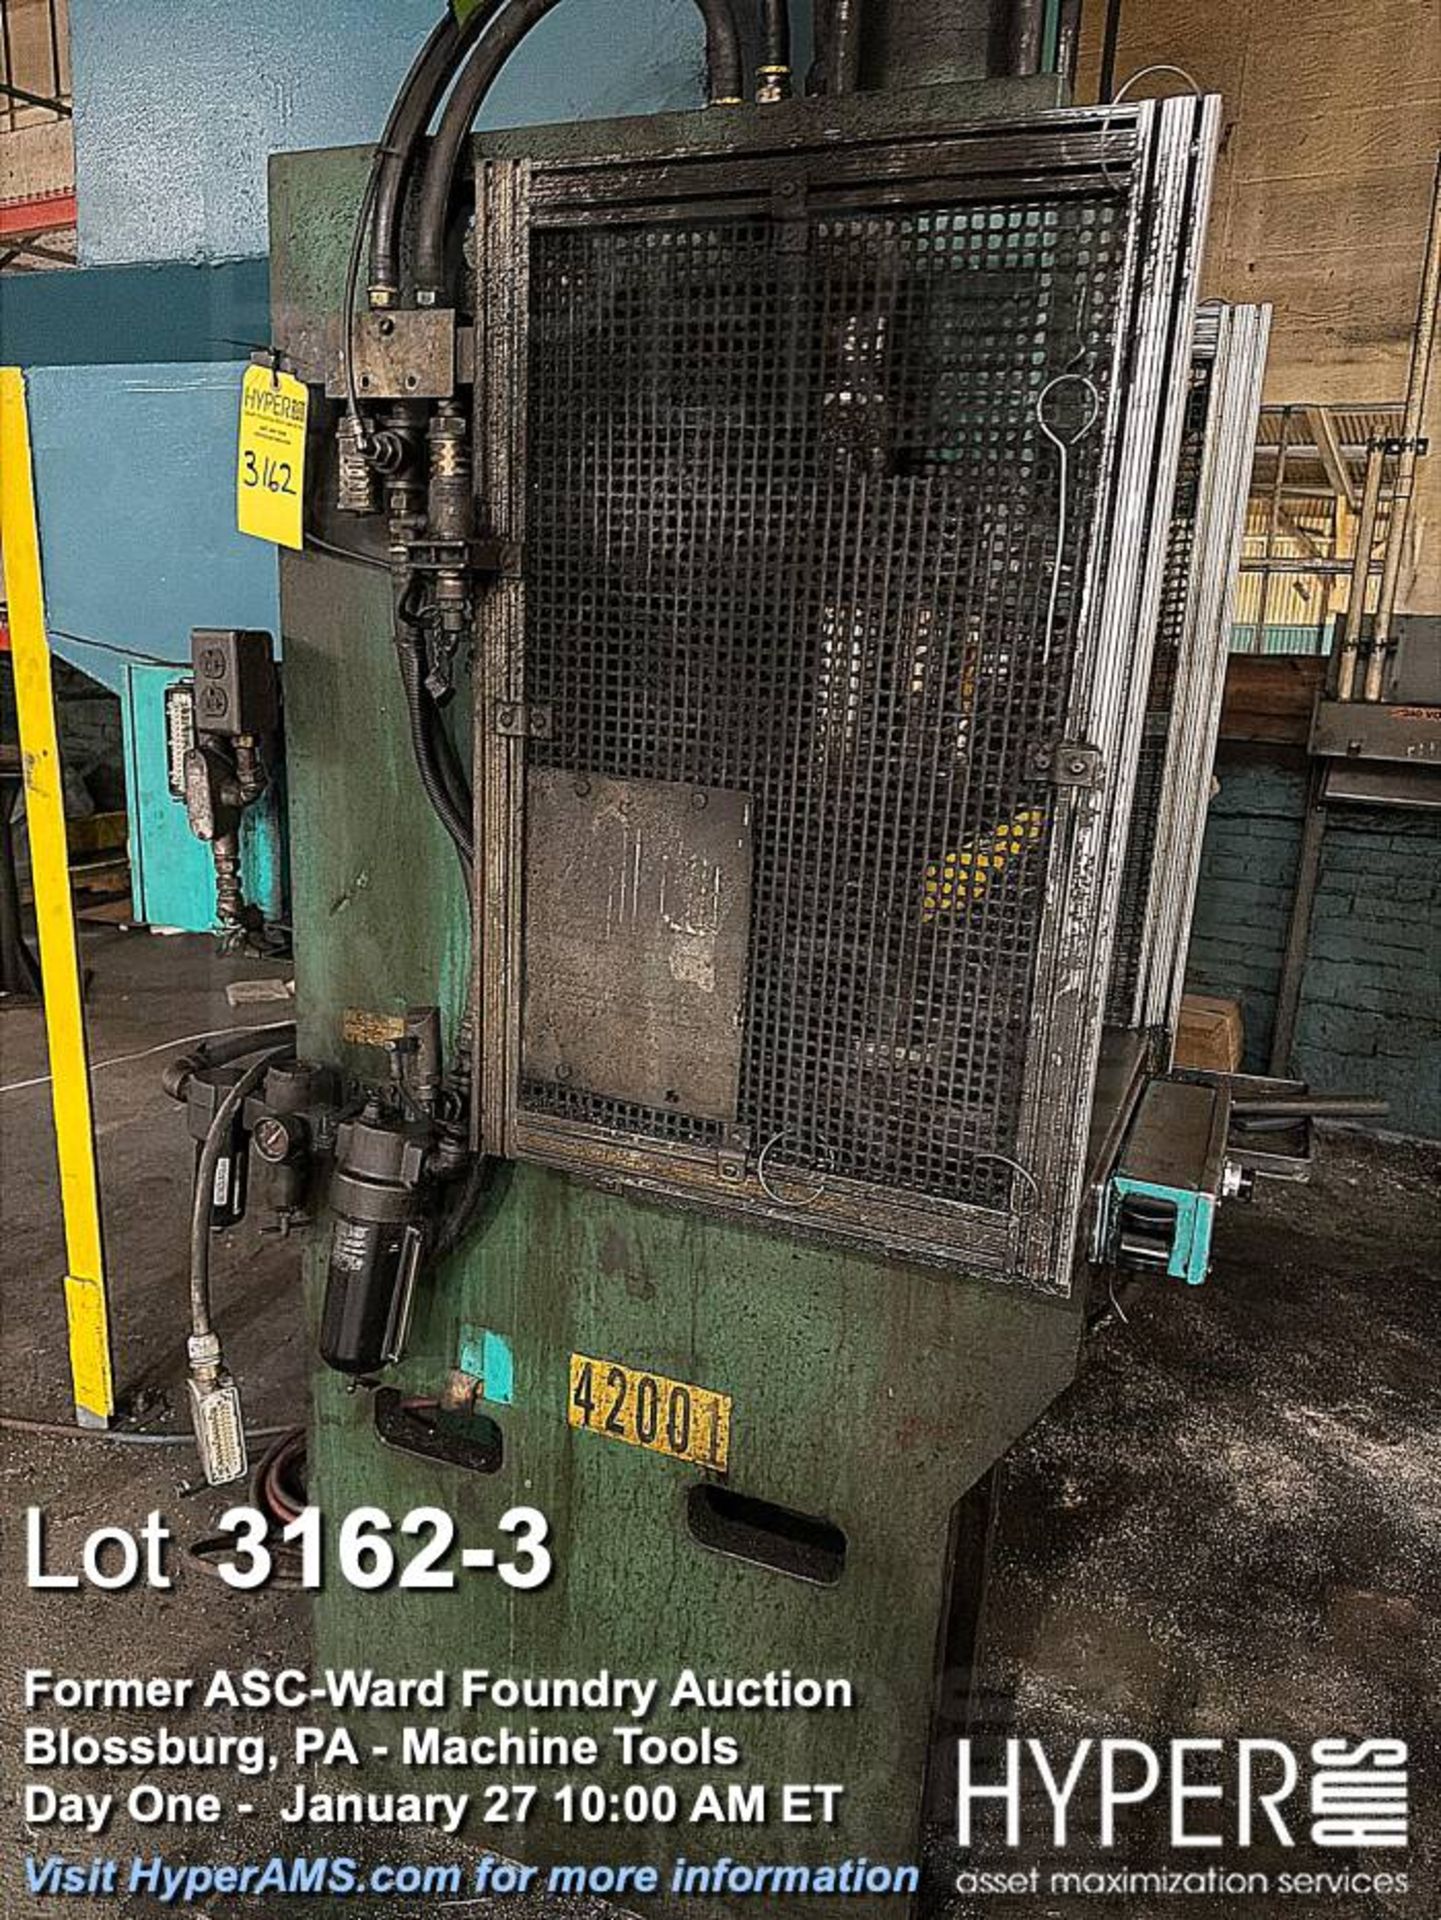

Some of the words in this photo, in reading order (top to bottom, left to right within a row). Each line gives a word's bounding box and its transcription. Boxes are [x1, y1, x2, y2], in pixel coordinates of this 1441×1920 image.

[244, 387, 291, 418] HYPER
[243, 450, 297, 494] 3162
[573, 1361, 721, 1466] 42001
